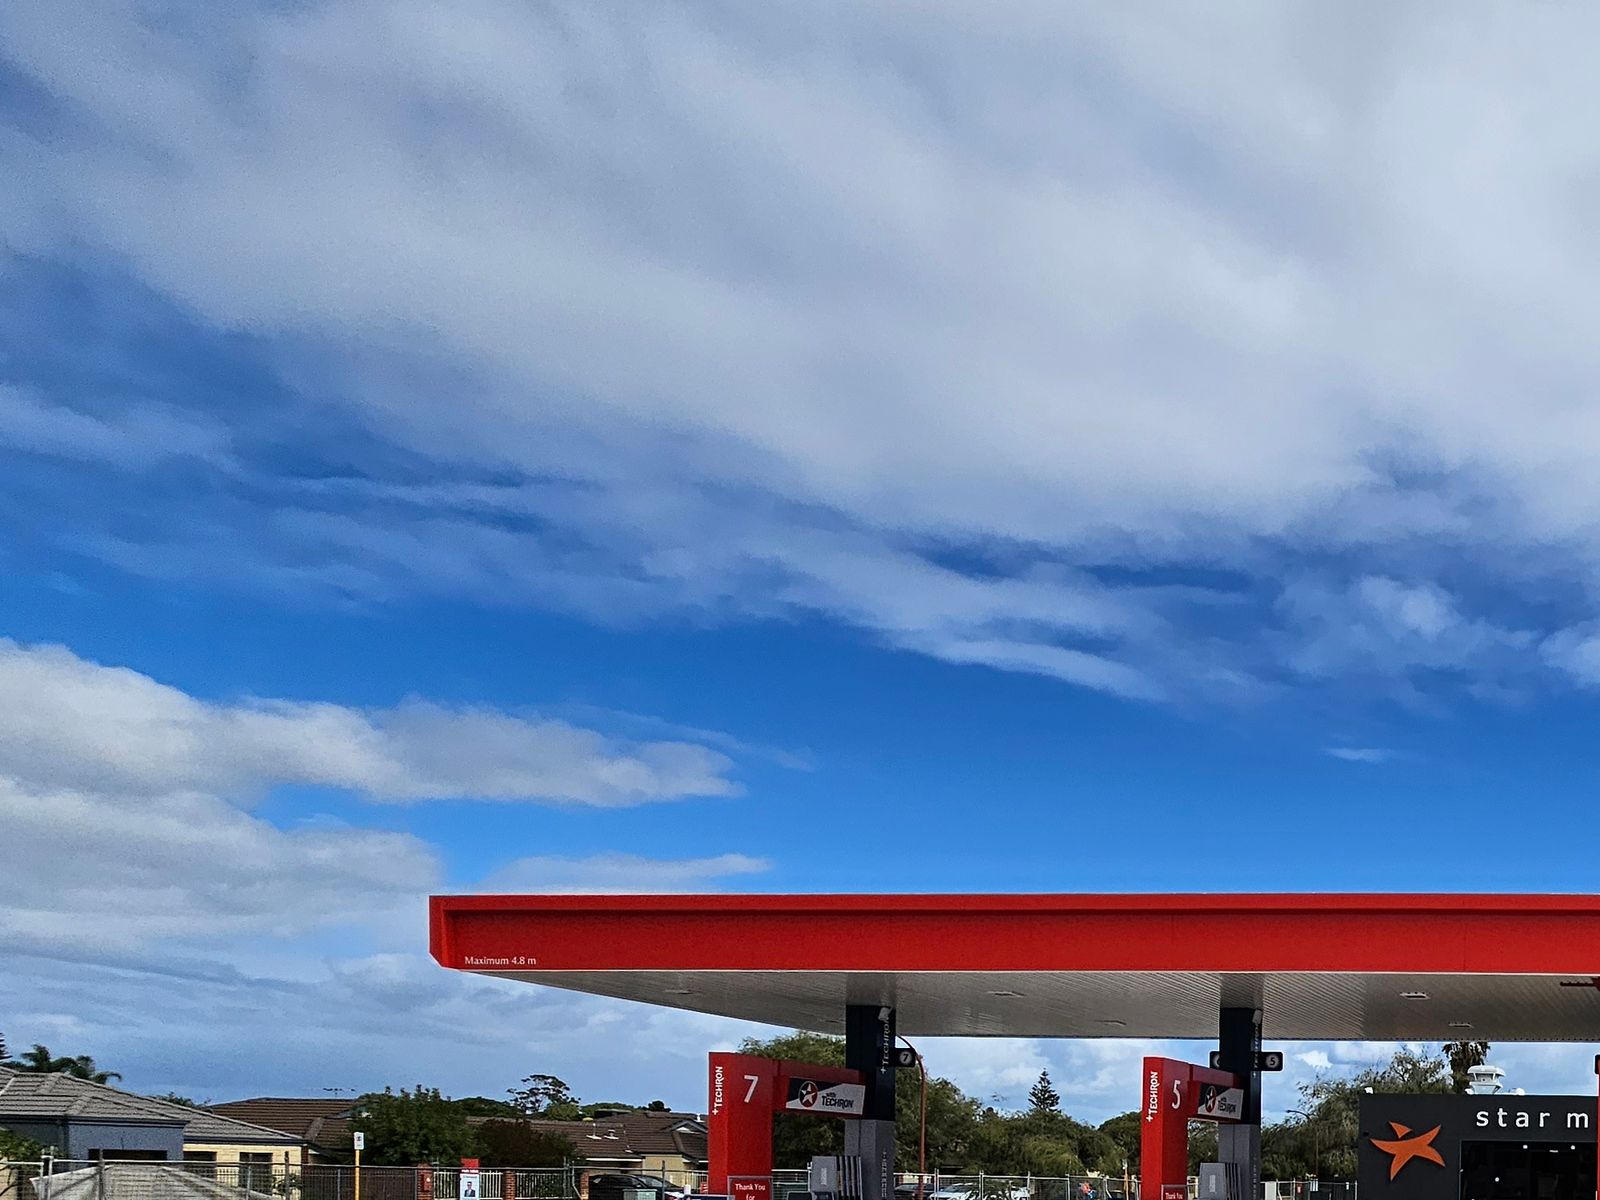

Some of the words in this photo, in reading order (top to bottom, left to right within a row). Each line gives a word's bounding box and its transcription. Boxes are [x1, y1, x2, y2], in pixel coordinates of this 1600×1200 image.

[464, 956, 509, 965] Maximum
[511, 956, 525, 965] 4.8
[527, 957, 537, 965] m
[902, 1053, 909, 1062] 7
[1270, 1057, 1276, 1066] 5
[743, 1074, 759, 1103] 7
[1171, 1079, 1181, 1110] 5
[821, 1096, 855, 1110] TECHRON
[1476, 1107, 1551, 1128] star
[735, 1183, 753, 1191] Thank
[754, 1183, 766, 1191] You
